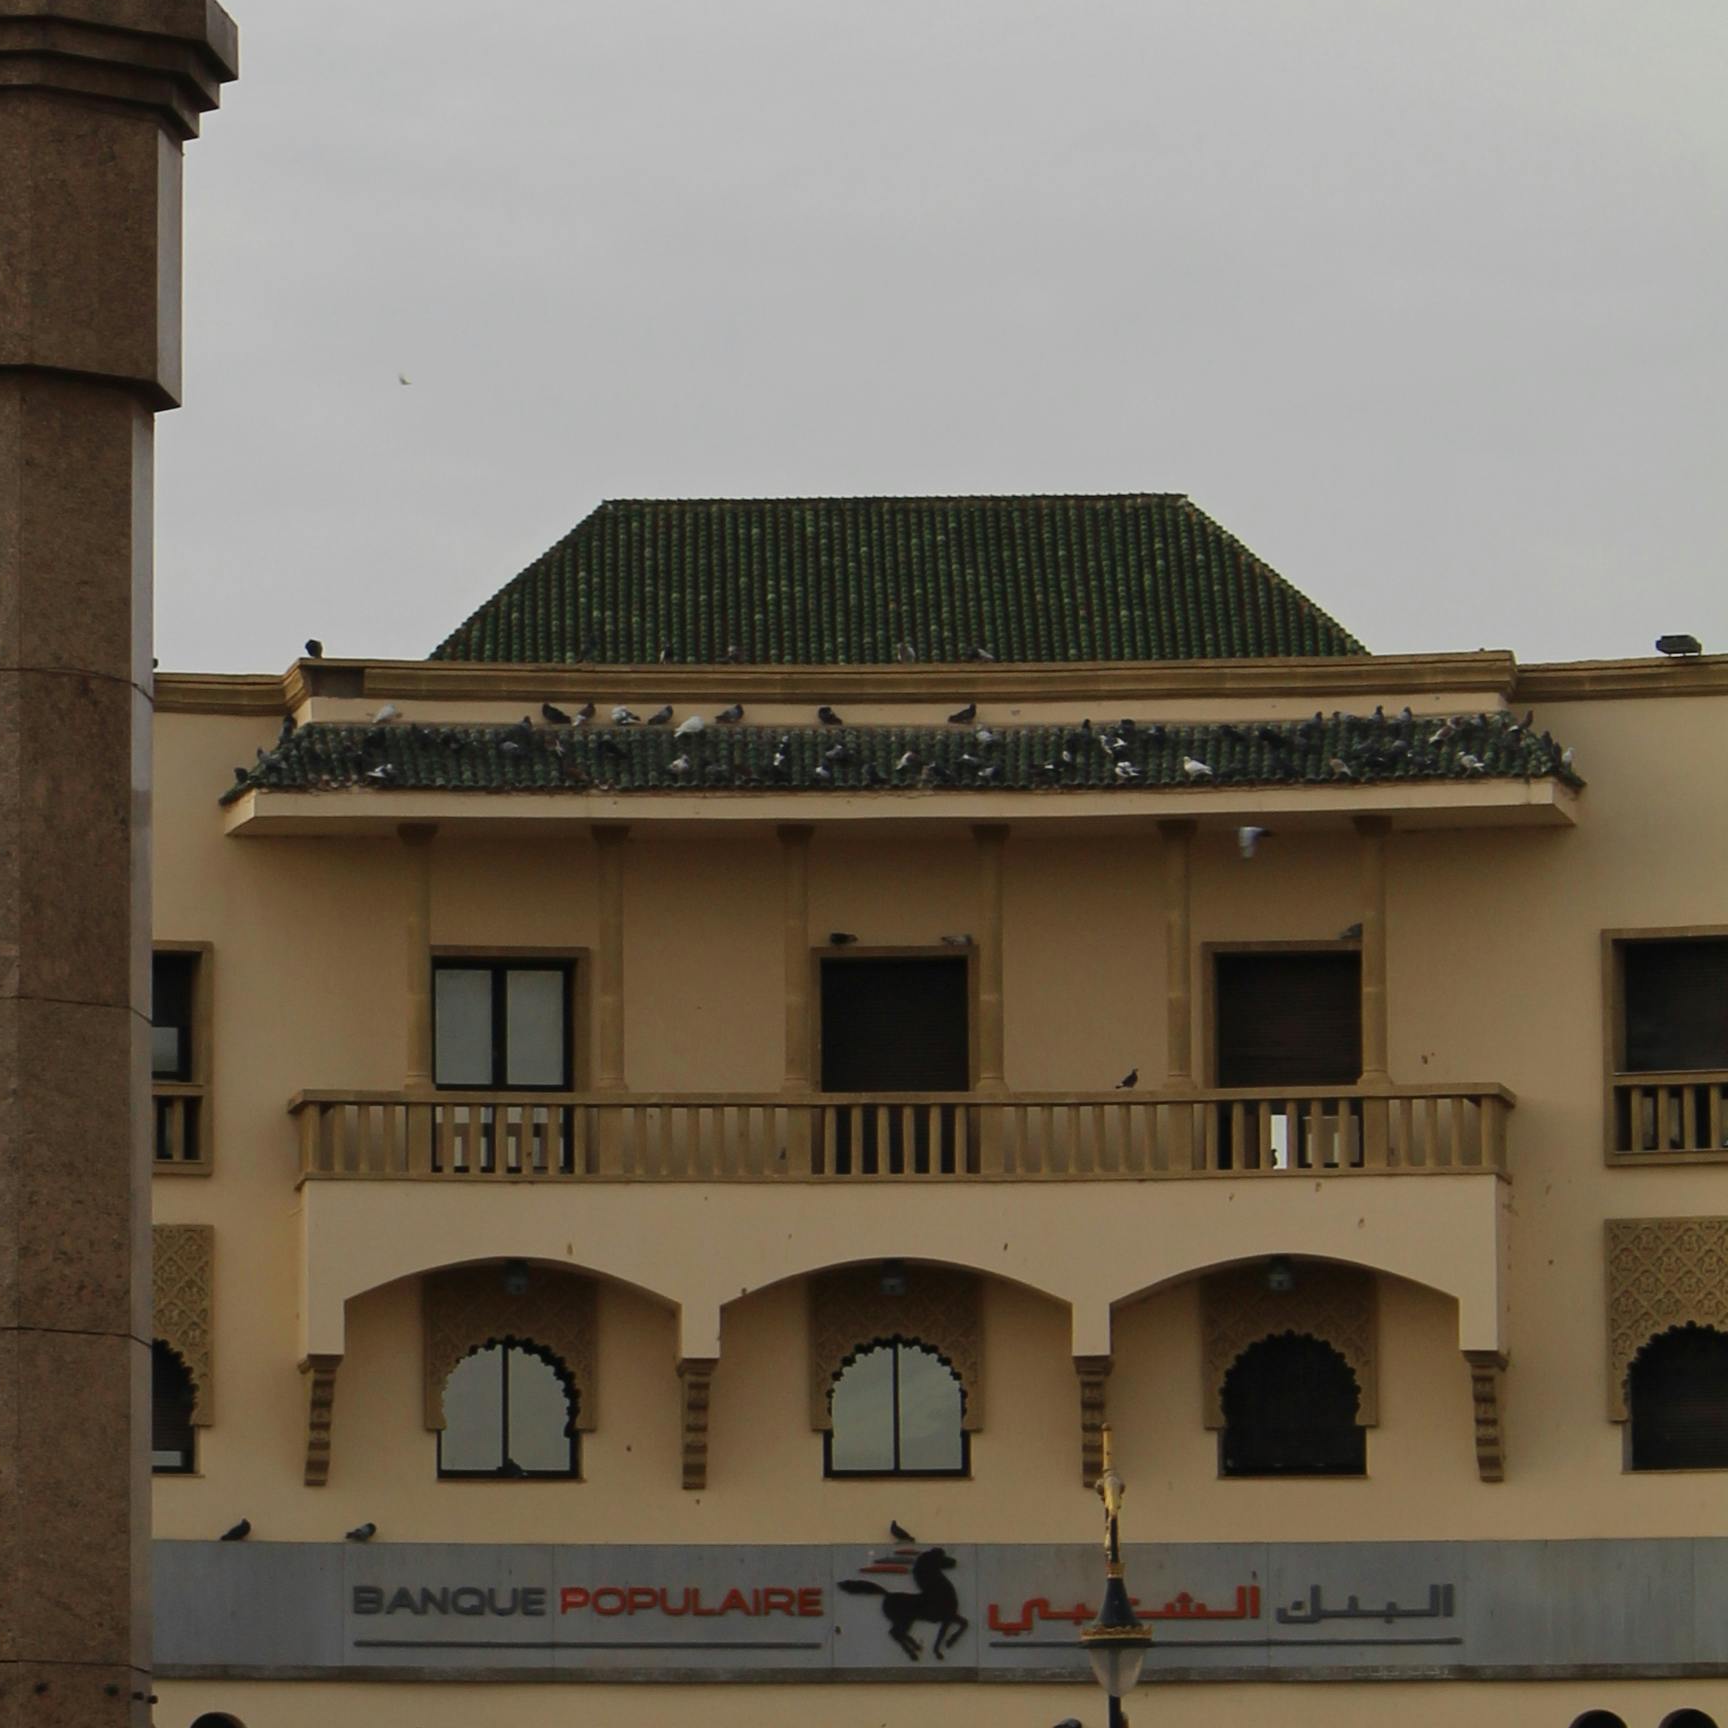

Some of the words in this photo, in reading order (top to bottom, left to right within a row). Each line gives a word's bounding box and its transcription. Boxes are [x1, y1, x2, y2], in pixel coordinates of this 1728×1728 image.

[351, 1585, 547, 1617] BANQUE
[560, 1586, 825, 1617] POPULAIRE
[1276, 1583, 1454, 1624] البنك
